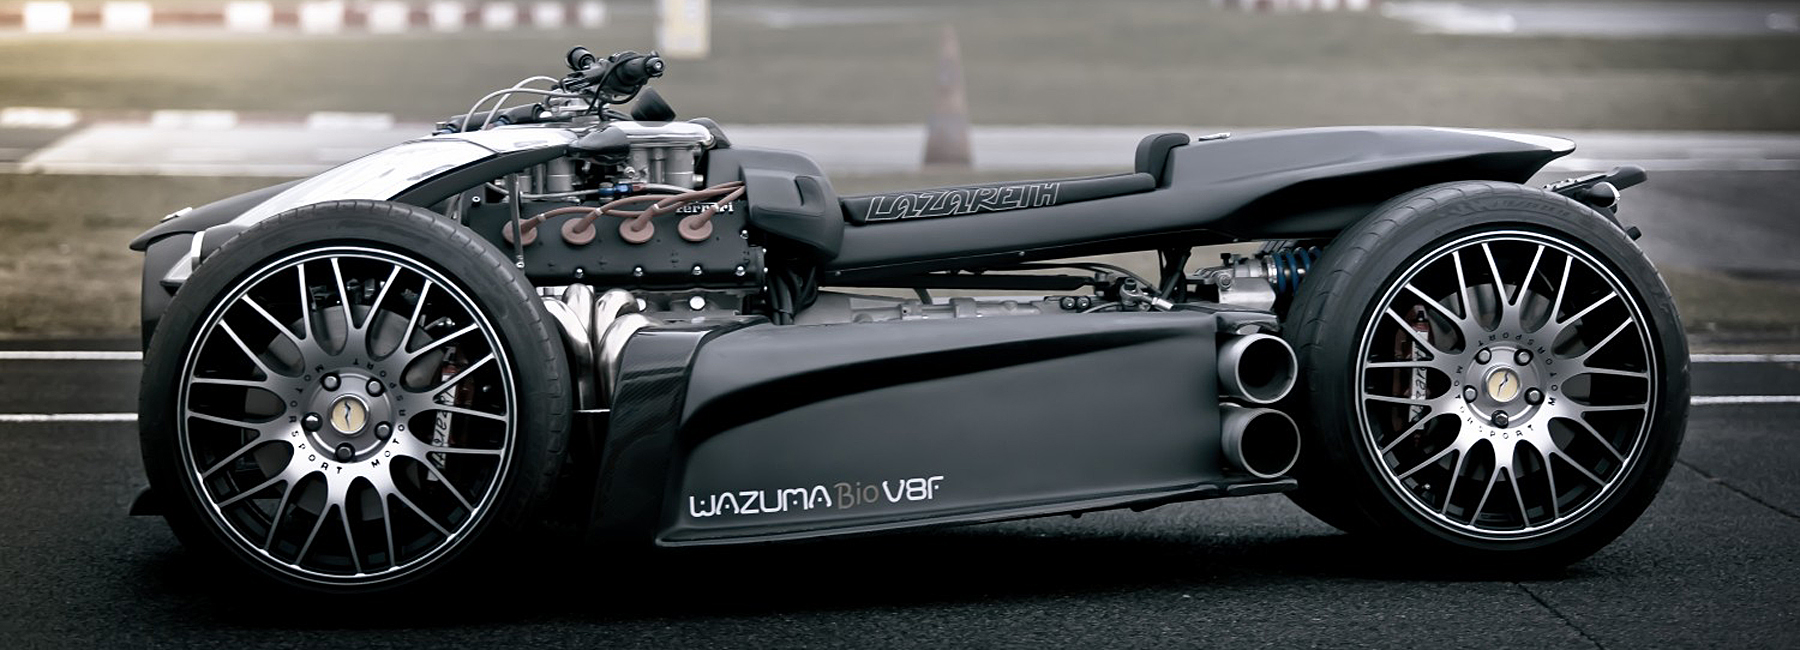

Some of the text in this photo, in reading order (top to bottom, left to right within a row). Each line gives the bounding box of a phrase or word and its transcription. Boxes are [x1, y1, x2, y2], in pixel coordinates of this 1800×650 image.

[865, 182, 1060, 221] LAZARETH
[689, 475, 944, 517] WAZUMA Bio V8F
